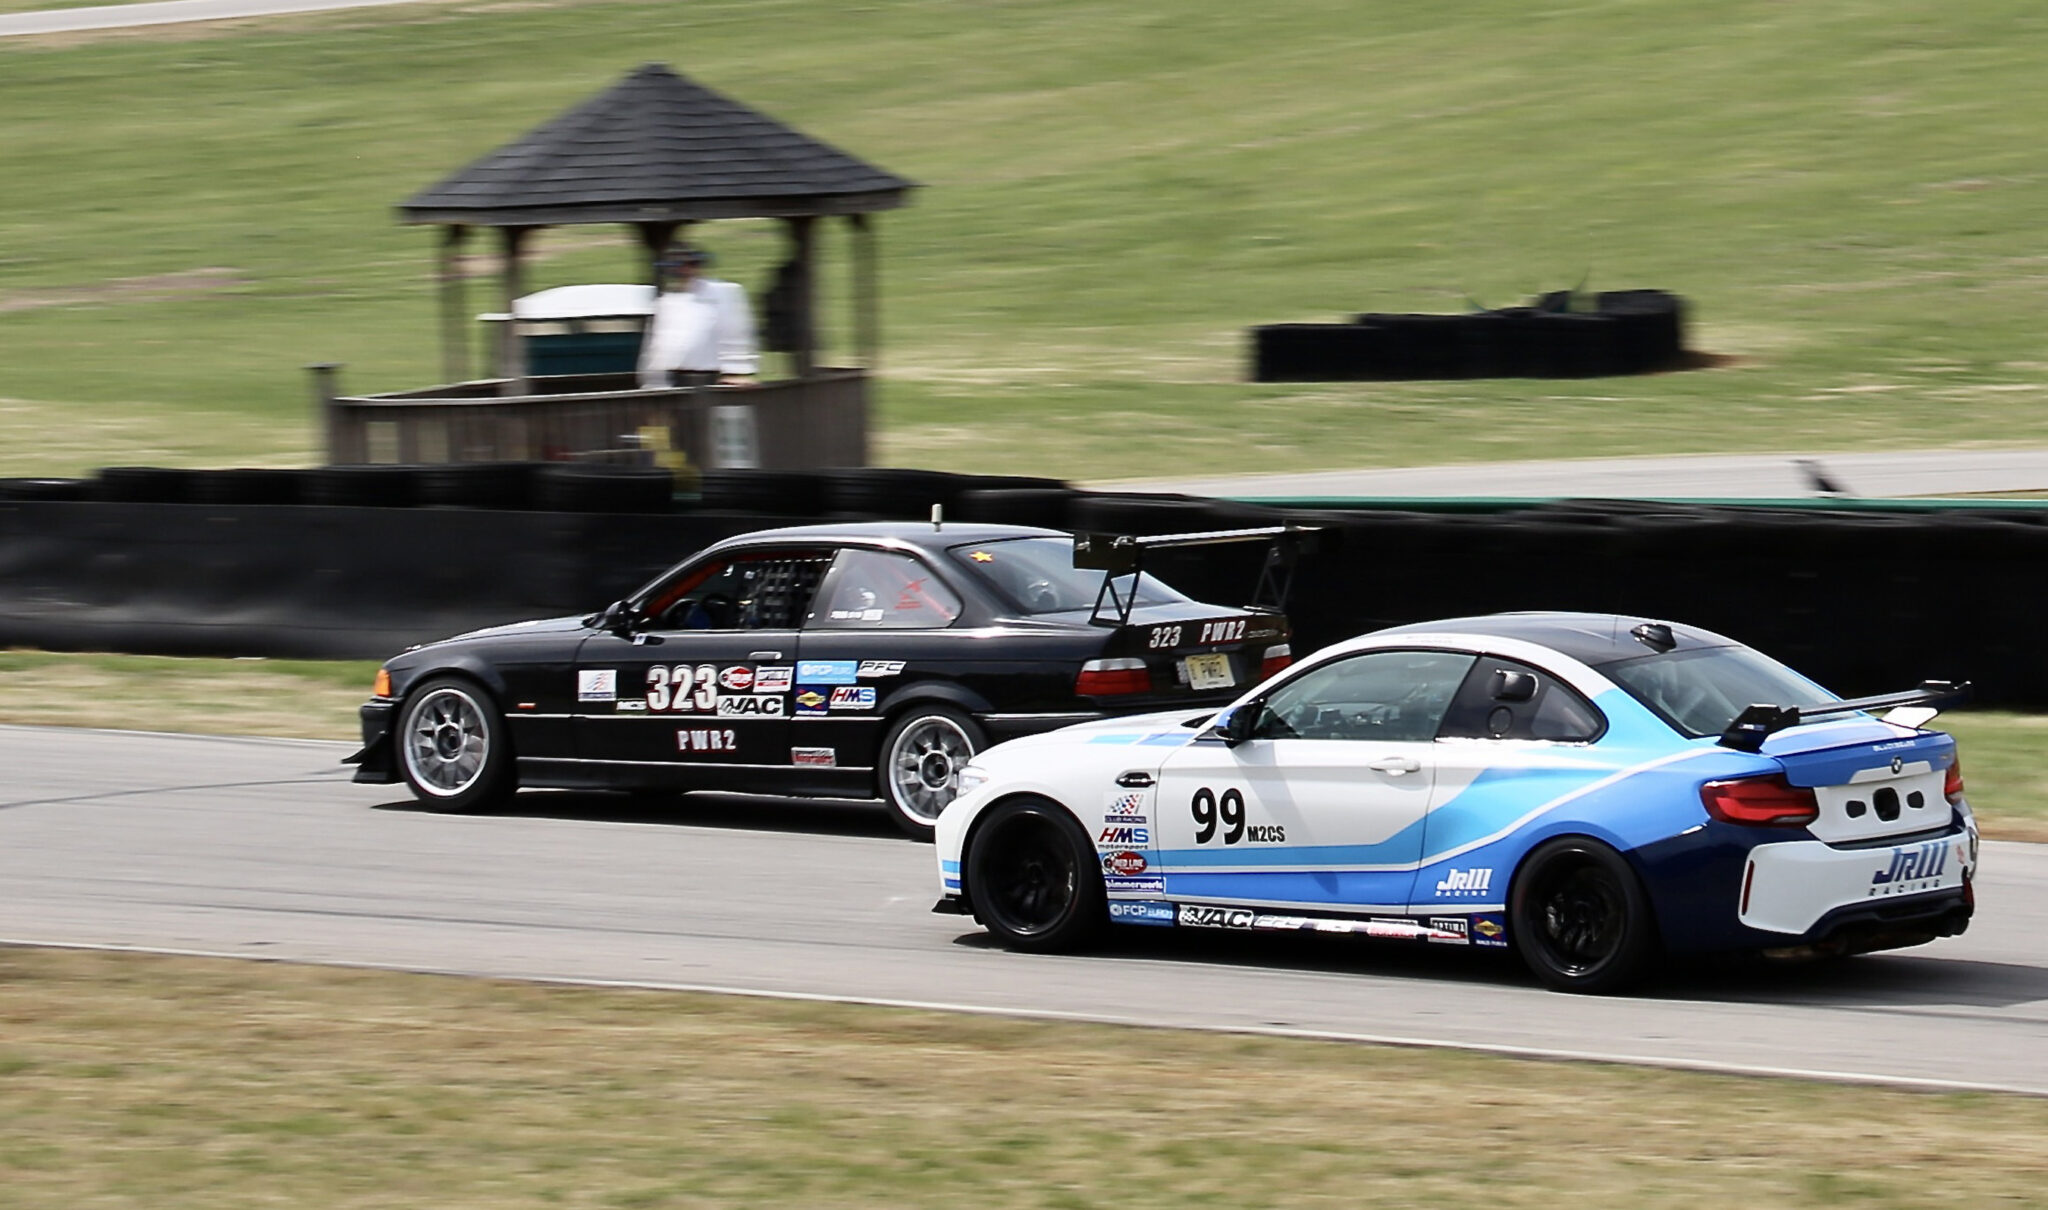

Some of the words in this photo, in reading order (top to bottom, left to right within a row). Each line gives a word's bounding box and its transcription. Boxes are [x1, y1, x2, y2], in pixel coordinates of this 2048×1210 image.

[1149, 625, 1182, 648] 323
[1200, 620, 1246, 643] PWR2
[646, 664, 717, 711] 323
[832, 689, 874, 702] HMS
[677, 730, 737, 750] PWR2
[1191, 787, 1246, 845] 99
[1247, 825, 1285, 842] M2CS
[1098, 828, 1149, 843] HMS
[1123, 905, 1147, 915] FCP
